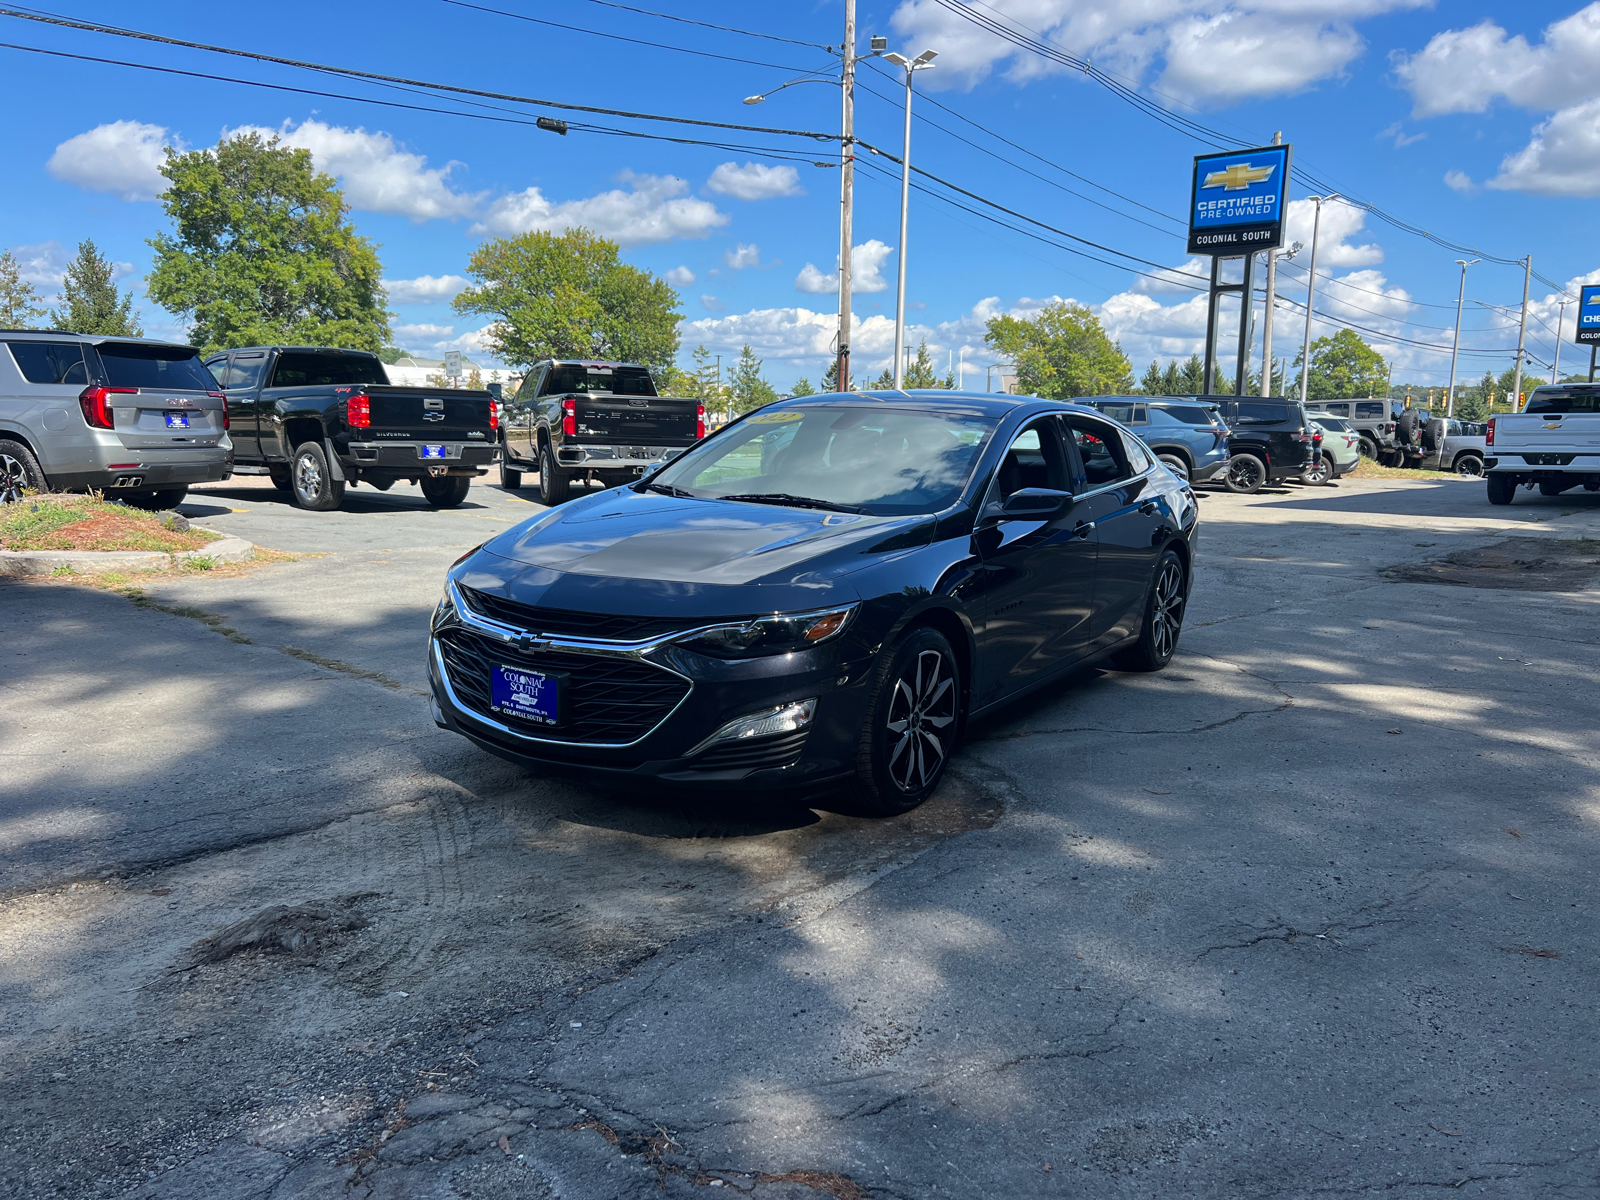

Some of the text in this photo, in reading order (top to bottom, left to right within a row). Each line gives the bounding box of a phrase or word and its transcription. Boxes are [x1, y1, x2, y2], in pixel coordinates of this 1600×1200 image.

[1197, 195, 1275, 210] CERTIFIED
[1200, 205, 1271, 219] PRE-OWNED
[1197, 231, 1271, 244] COLONIAL SOUTH
[504, 672, 545, 689] COLONIAL
[510, 682, 538, 696] SOUTH
[503, 708, 527, 718] COLONIAL
